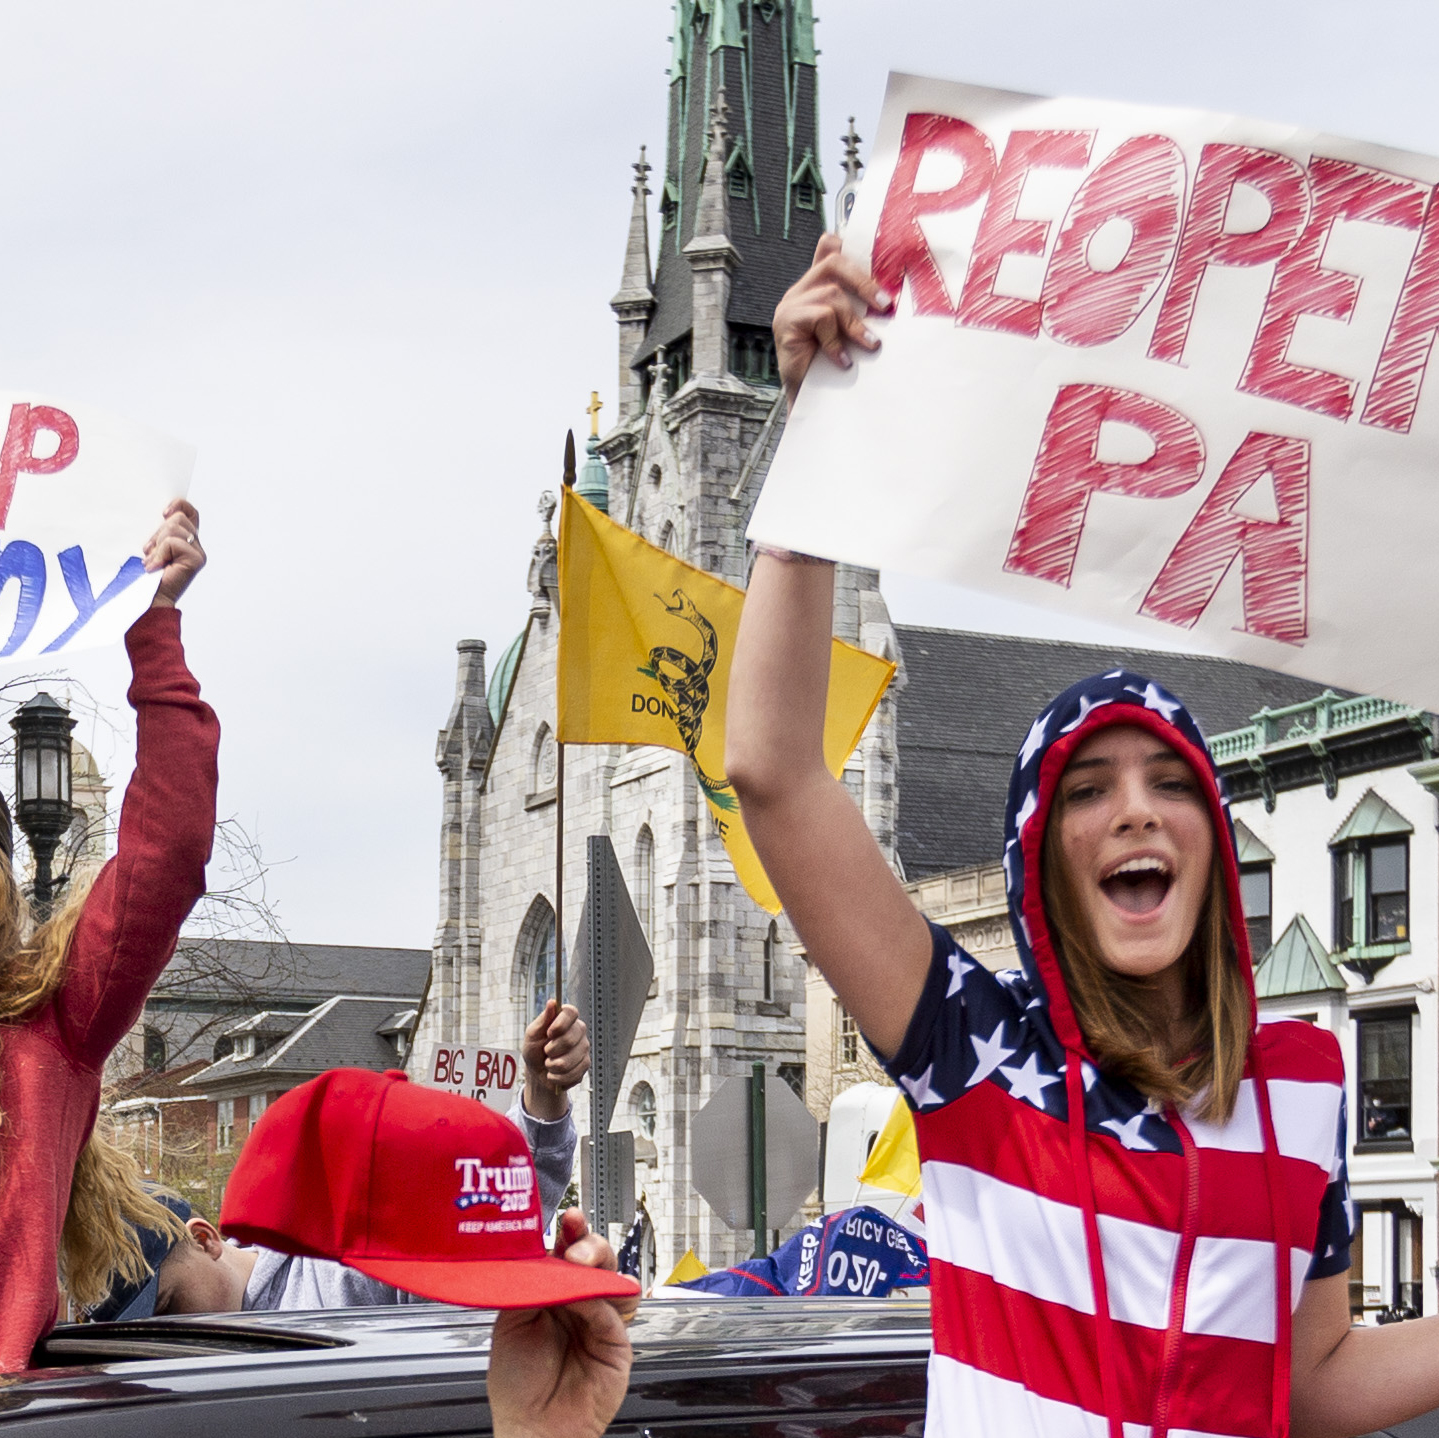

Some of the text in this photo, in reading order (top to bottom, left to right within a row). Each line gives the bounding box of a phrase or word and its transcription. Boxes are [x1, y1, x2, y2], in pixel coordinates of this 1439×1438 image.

[1001, 382, 1314, 647] PA
[433, 1048, 518, 1090] BIG BAD
[796, 1232, 820, 1292] KEEP
